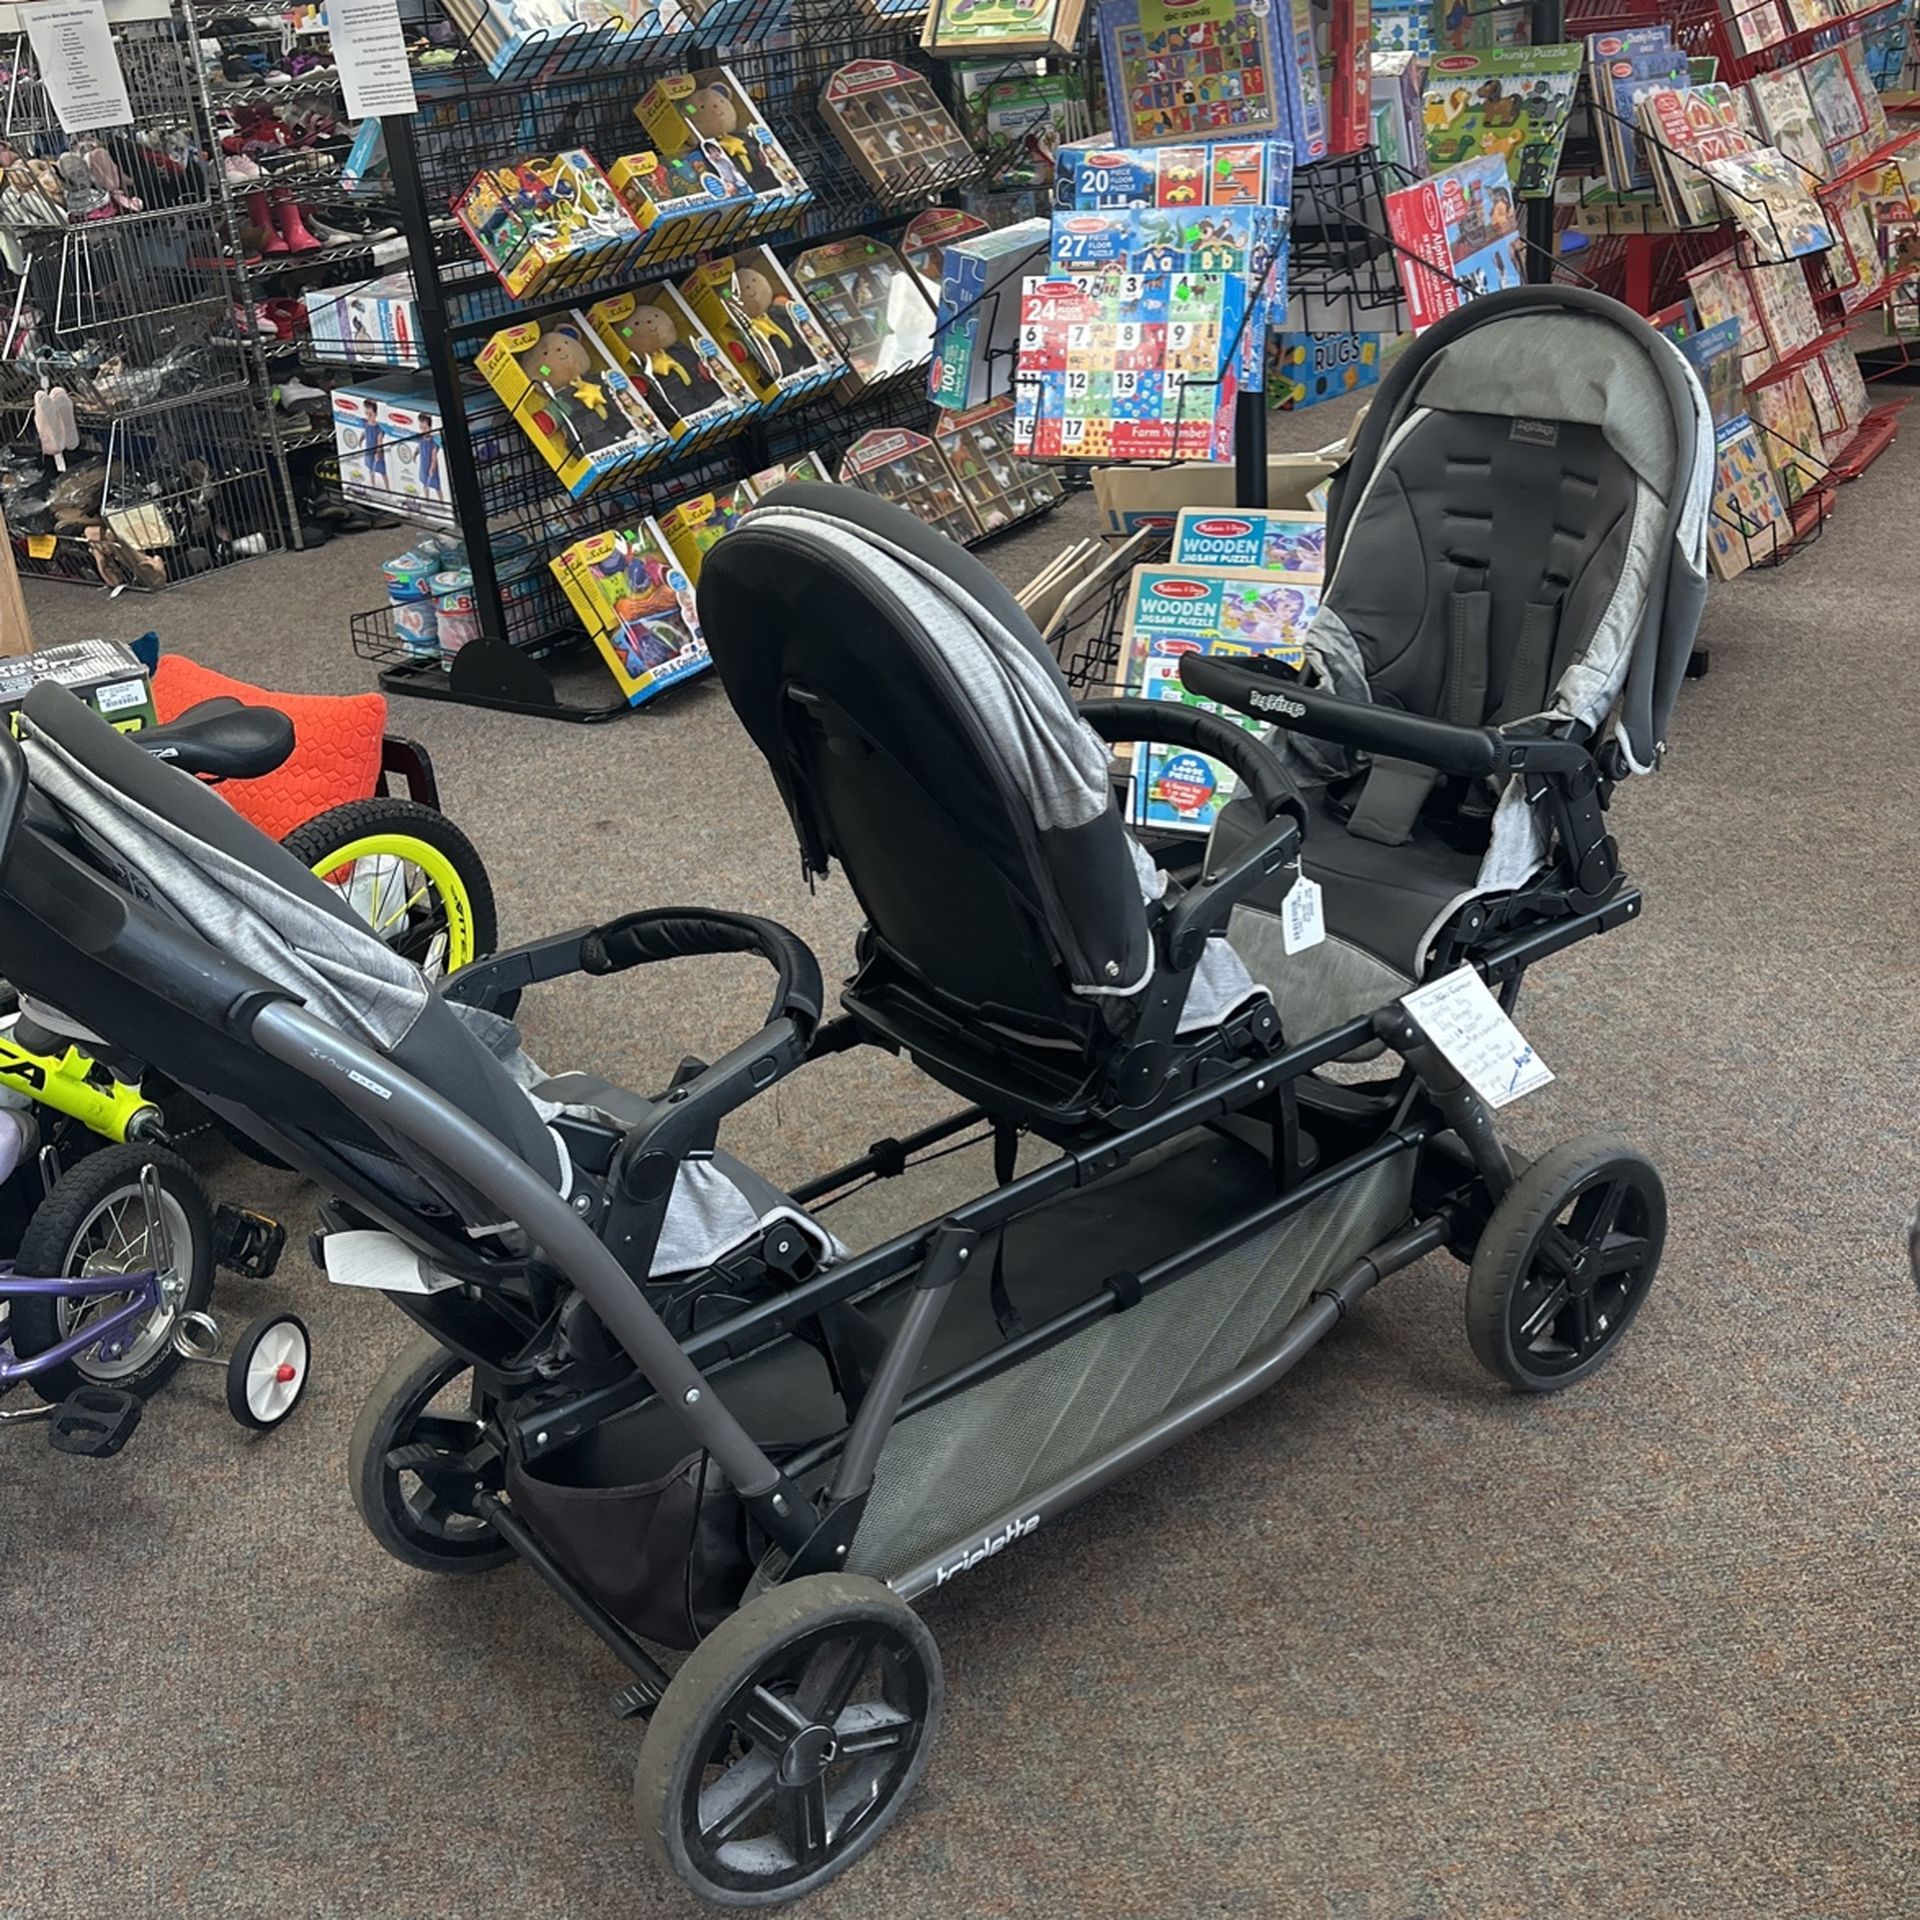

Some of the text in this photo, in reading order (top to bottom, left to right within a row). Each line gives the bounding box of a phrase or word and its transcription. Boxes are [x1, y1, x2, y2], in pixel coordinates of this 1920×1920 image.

[1533, 46, 1569, 59] Puzzle
[1081, 170, 1109, 193] 20
[1109, 184, 1136, 192] PUZZLE
[1058, 235, 1086, 258] 27
[1088, 241, 1112, 249] FLOOR
[1088, 249, 1114, 257] PUZZLE
[1432, 233, 1451, 285] Alphabt
[1078, 278, 1087, 293] 2
[1126, 277, 1137, 292] 3
[1027, 299, 1056, 321] 24
[1026, 325, 1185, 342] 6 7 8 9
[1314, 335, 1360, 372] RUGS
[941, 363, 956, 392] 100
[1069, 373, 1086, 389] 12
[1117, 373, 1135, 389] 13
[1018, 420, 1082, 436] 16 17
[1131, 425, 1207, 439] Farm Nmber
[1182, 537, 1260, 554] WOODEN
[1181, 553, 1257, 564] JIGSAW PUZZLE
[457, 596, 471, 609] B
[1141, 599, 1217, 618] WOODEN
[1139, 614, 1215, 627] JIGSAW PUZZLE
[1172, 763, 1205, 777] LOOSE
[1182, 759, 1198, 768] NO
[936, 1514, 1040, 1587] triplette
